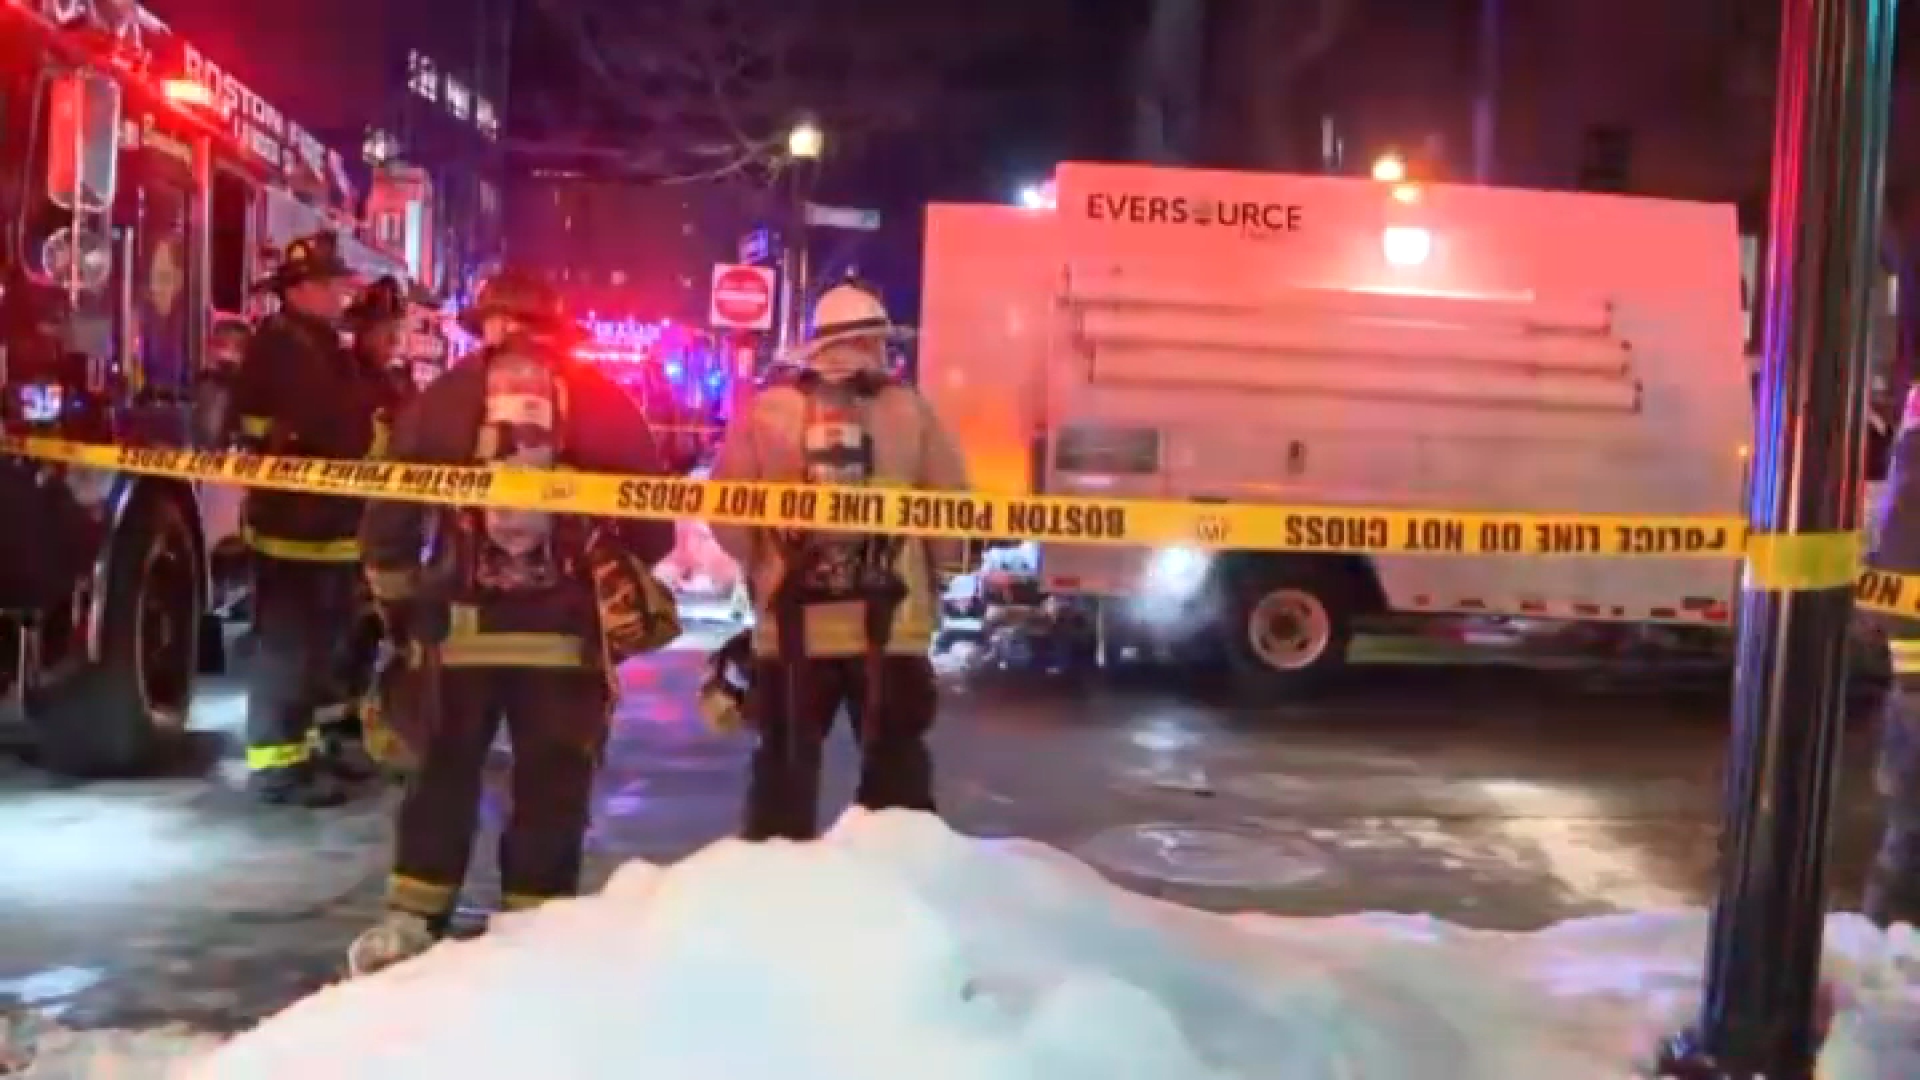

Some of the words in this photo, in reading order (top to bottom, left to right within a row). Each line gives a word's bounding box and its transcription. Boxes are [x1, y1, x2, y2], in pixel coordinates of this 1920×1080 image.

[184, 40, 284, 134] BOSTON
[616, 479, 704, 513] CROSS
[714, 485, 768, 517] NOT
[780, 488, 817, 520] DO
[827, 491, 885, 524] LINE
[896, 495, 993, 530] POLICE
[1007, 501, 1125, 537] BOSTON
[1284, 513, 1388, 547] CROSS
[1403, 517, 1464, 551] NOT
[1479, 520, 1521, 552] DO
[1535, 521, 1600, 553] LINE
[1616, 525, 1727, 553] POLICE
